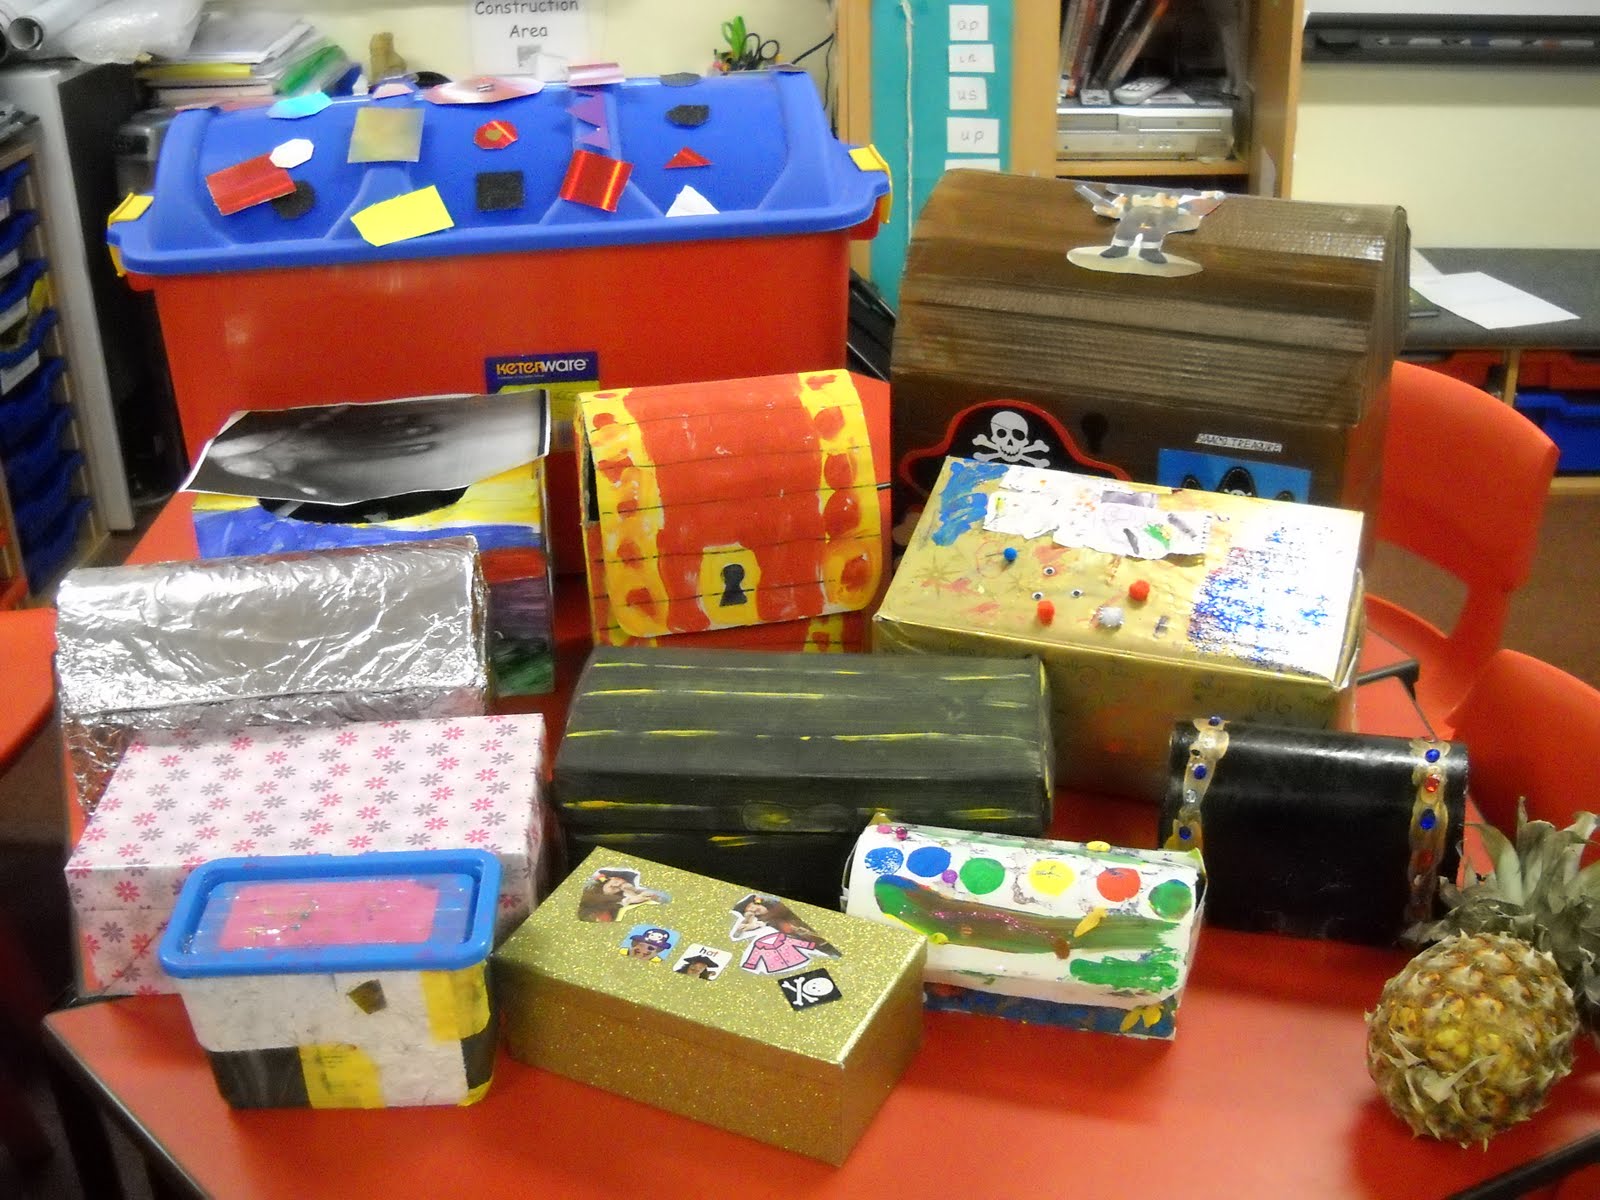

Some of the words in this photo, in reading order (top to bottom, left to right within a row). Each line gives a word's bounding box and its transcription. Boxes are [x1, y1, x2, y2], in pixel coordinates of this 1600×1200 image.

[474, 0, 579, 15] Construction
[509, 25, 548, 38] Area
[699, 946, 720, 958] hat
